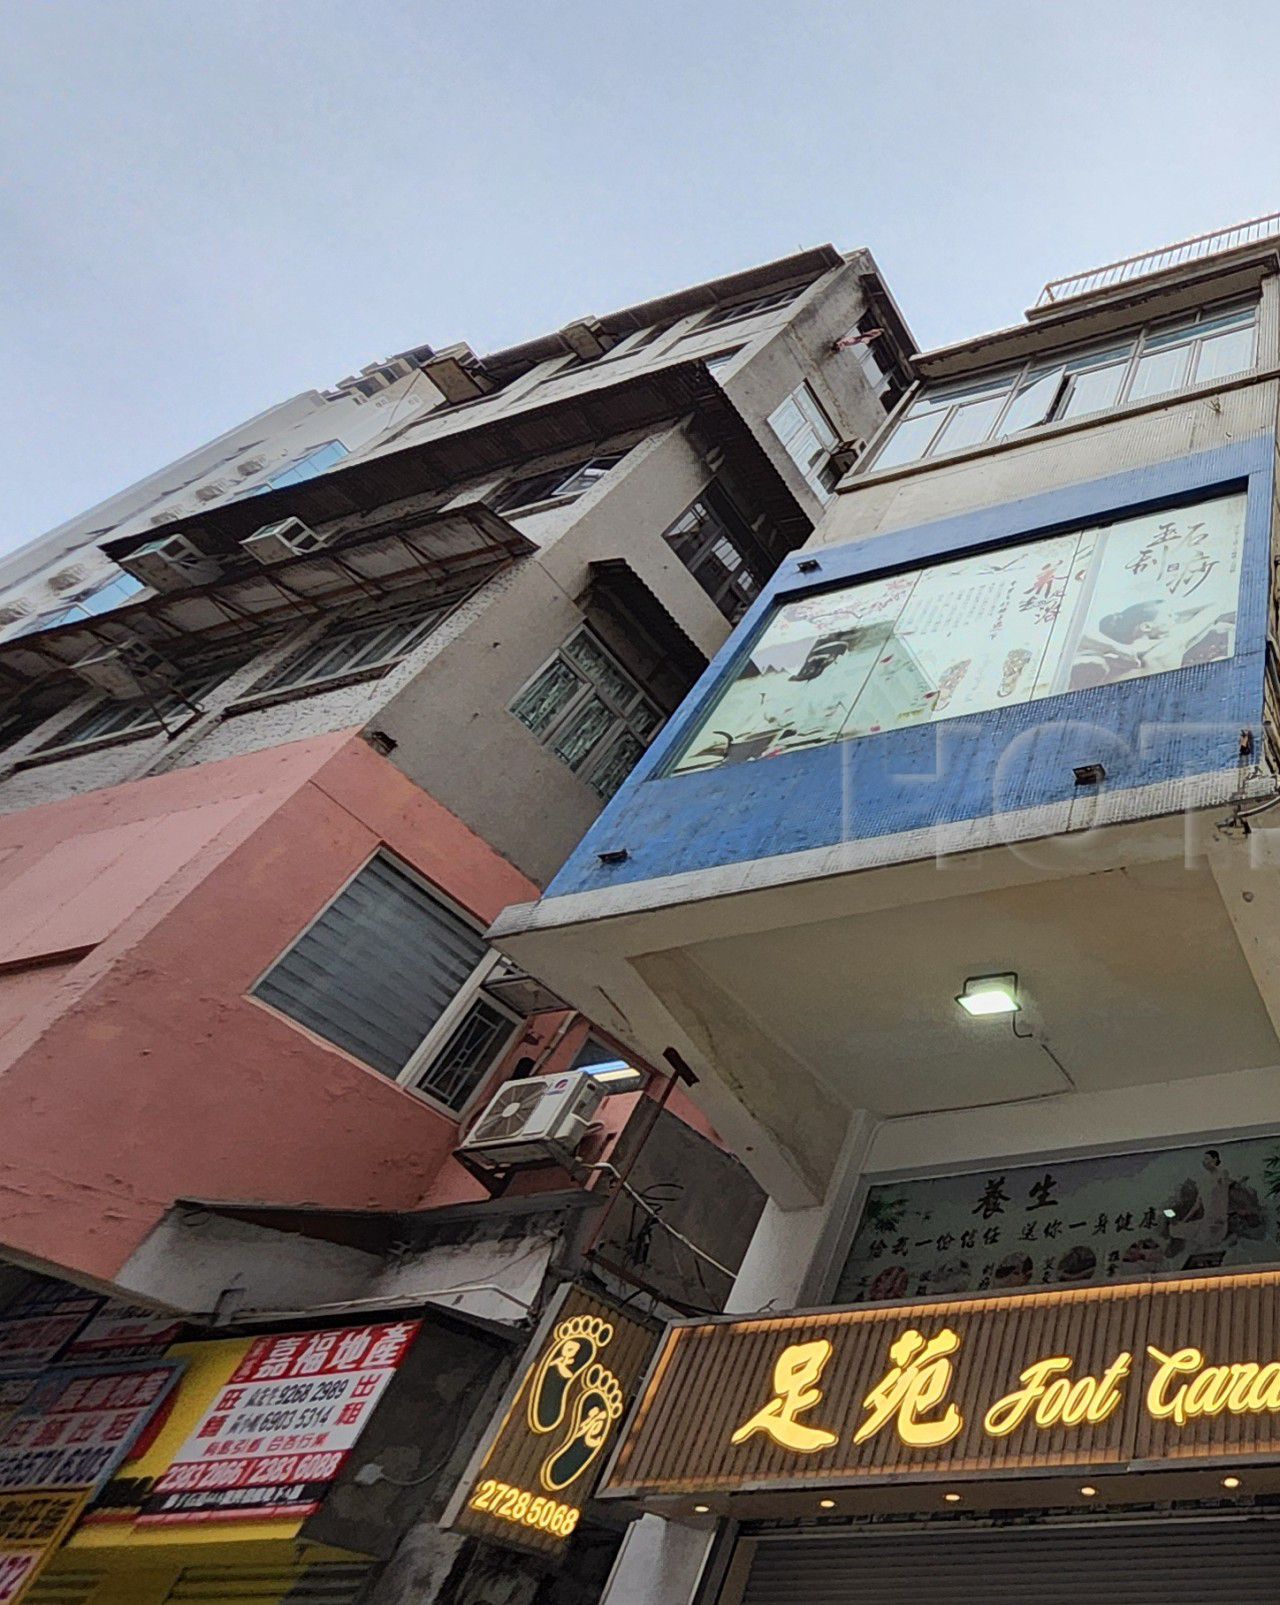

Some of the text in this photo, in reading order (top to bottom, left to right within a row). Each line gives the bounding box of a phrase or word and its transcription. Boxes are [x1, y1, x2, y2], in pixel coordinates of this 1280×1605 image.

[252, 1323, 415, 1380] 嘉福地產
[275, 1382, 310, 1405] 9268
[314, 1378, 350, 1401] 2989
[731, 1328, 963, 1453] 足苑
[983, 1352, 1132, 1437] Foot
[258, 1408, 296, 1431] 6903
[297, 1404, 335, 1428] 5314
[292, 1451, 344, 1482] 6088
